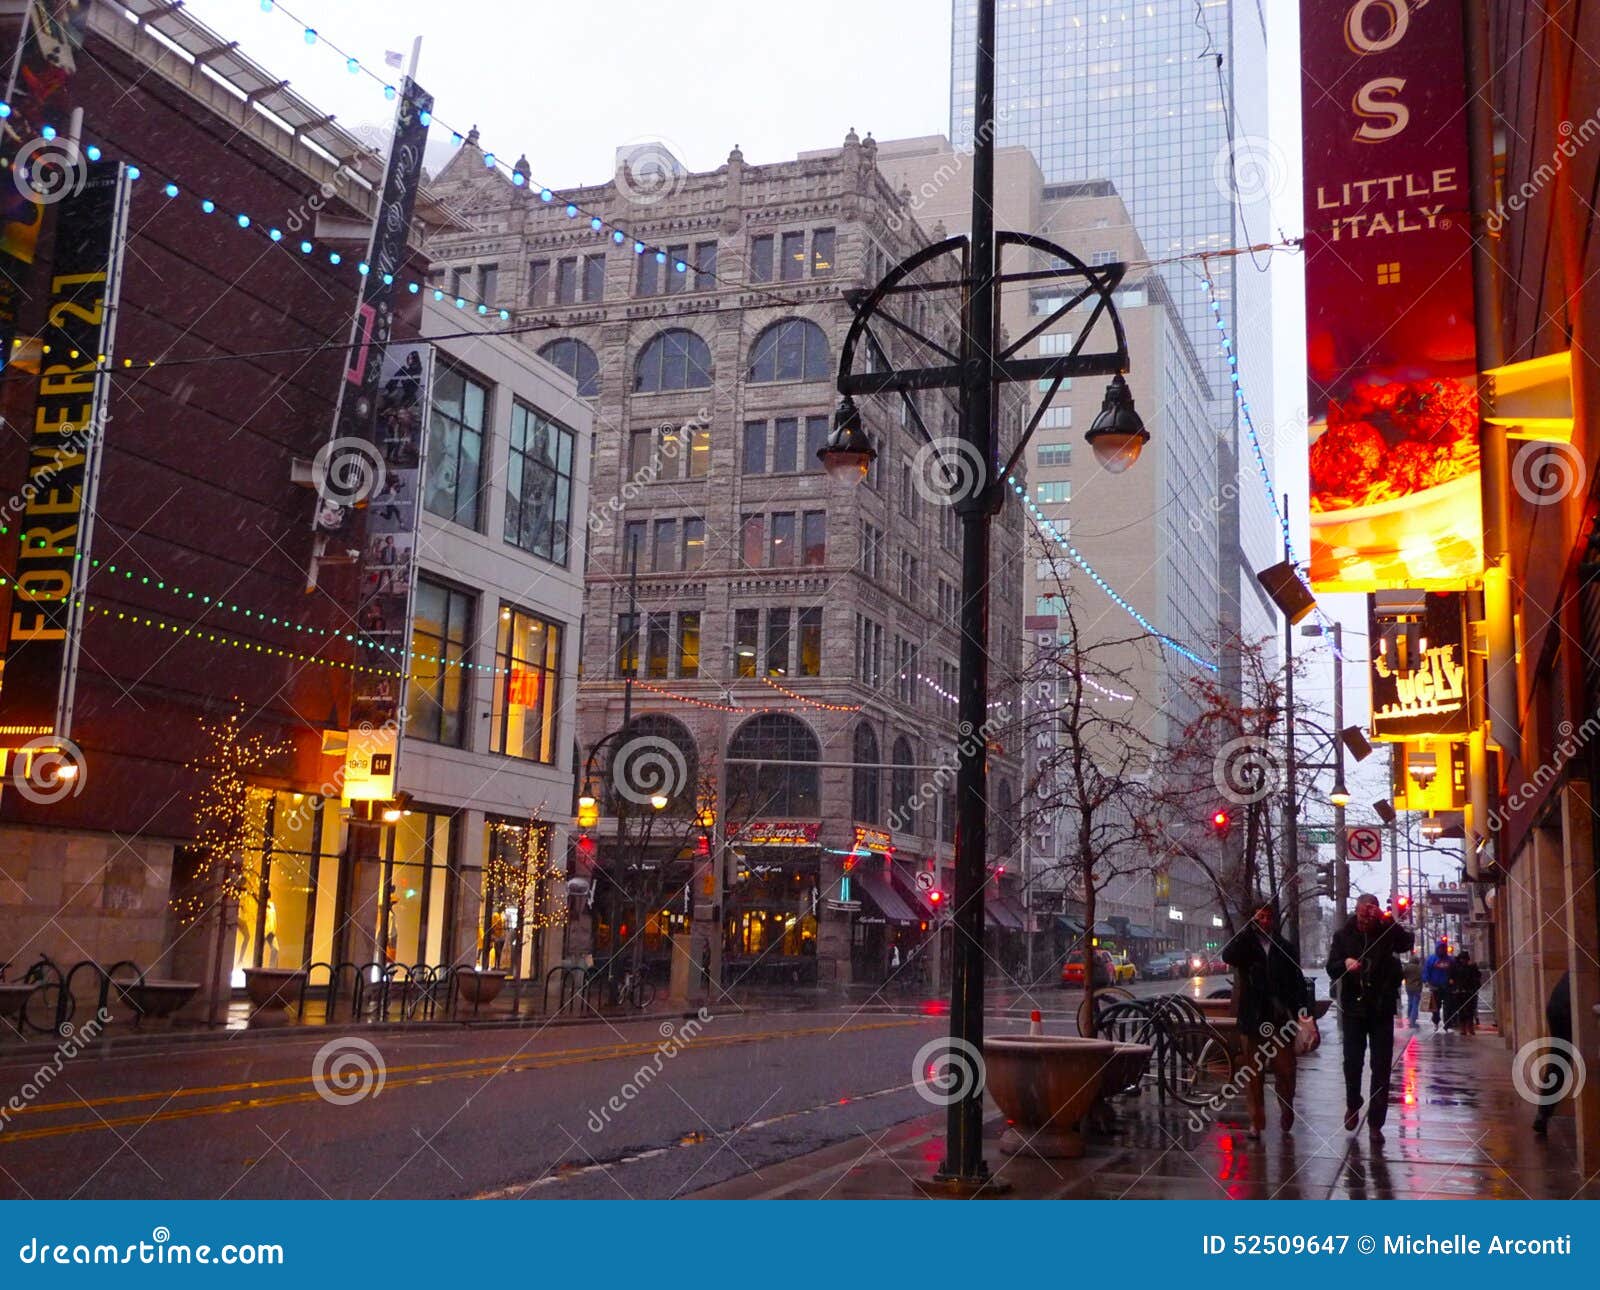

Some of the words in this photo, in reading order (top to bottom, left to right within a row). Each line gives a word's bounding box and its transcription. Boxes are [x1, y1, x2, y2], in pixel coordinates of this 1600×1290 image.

[1317, 167, 1457, 209] LITTLE
[49, 270, 108, 329] 21
[10, 361, 98, 641] FOREVER
[1392, 665, 1464, 704] UGLY
